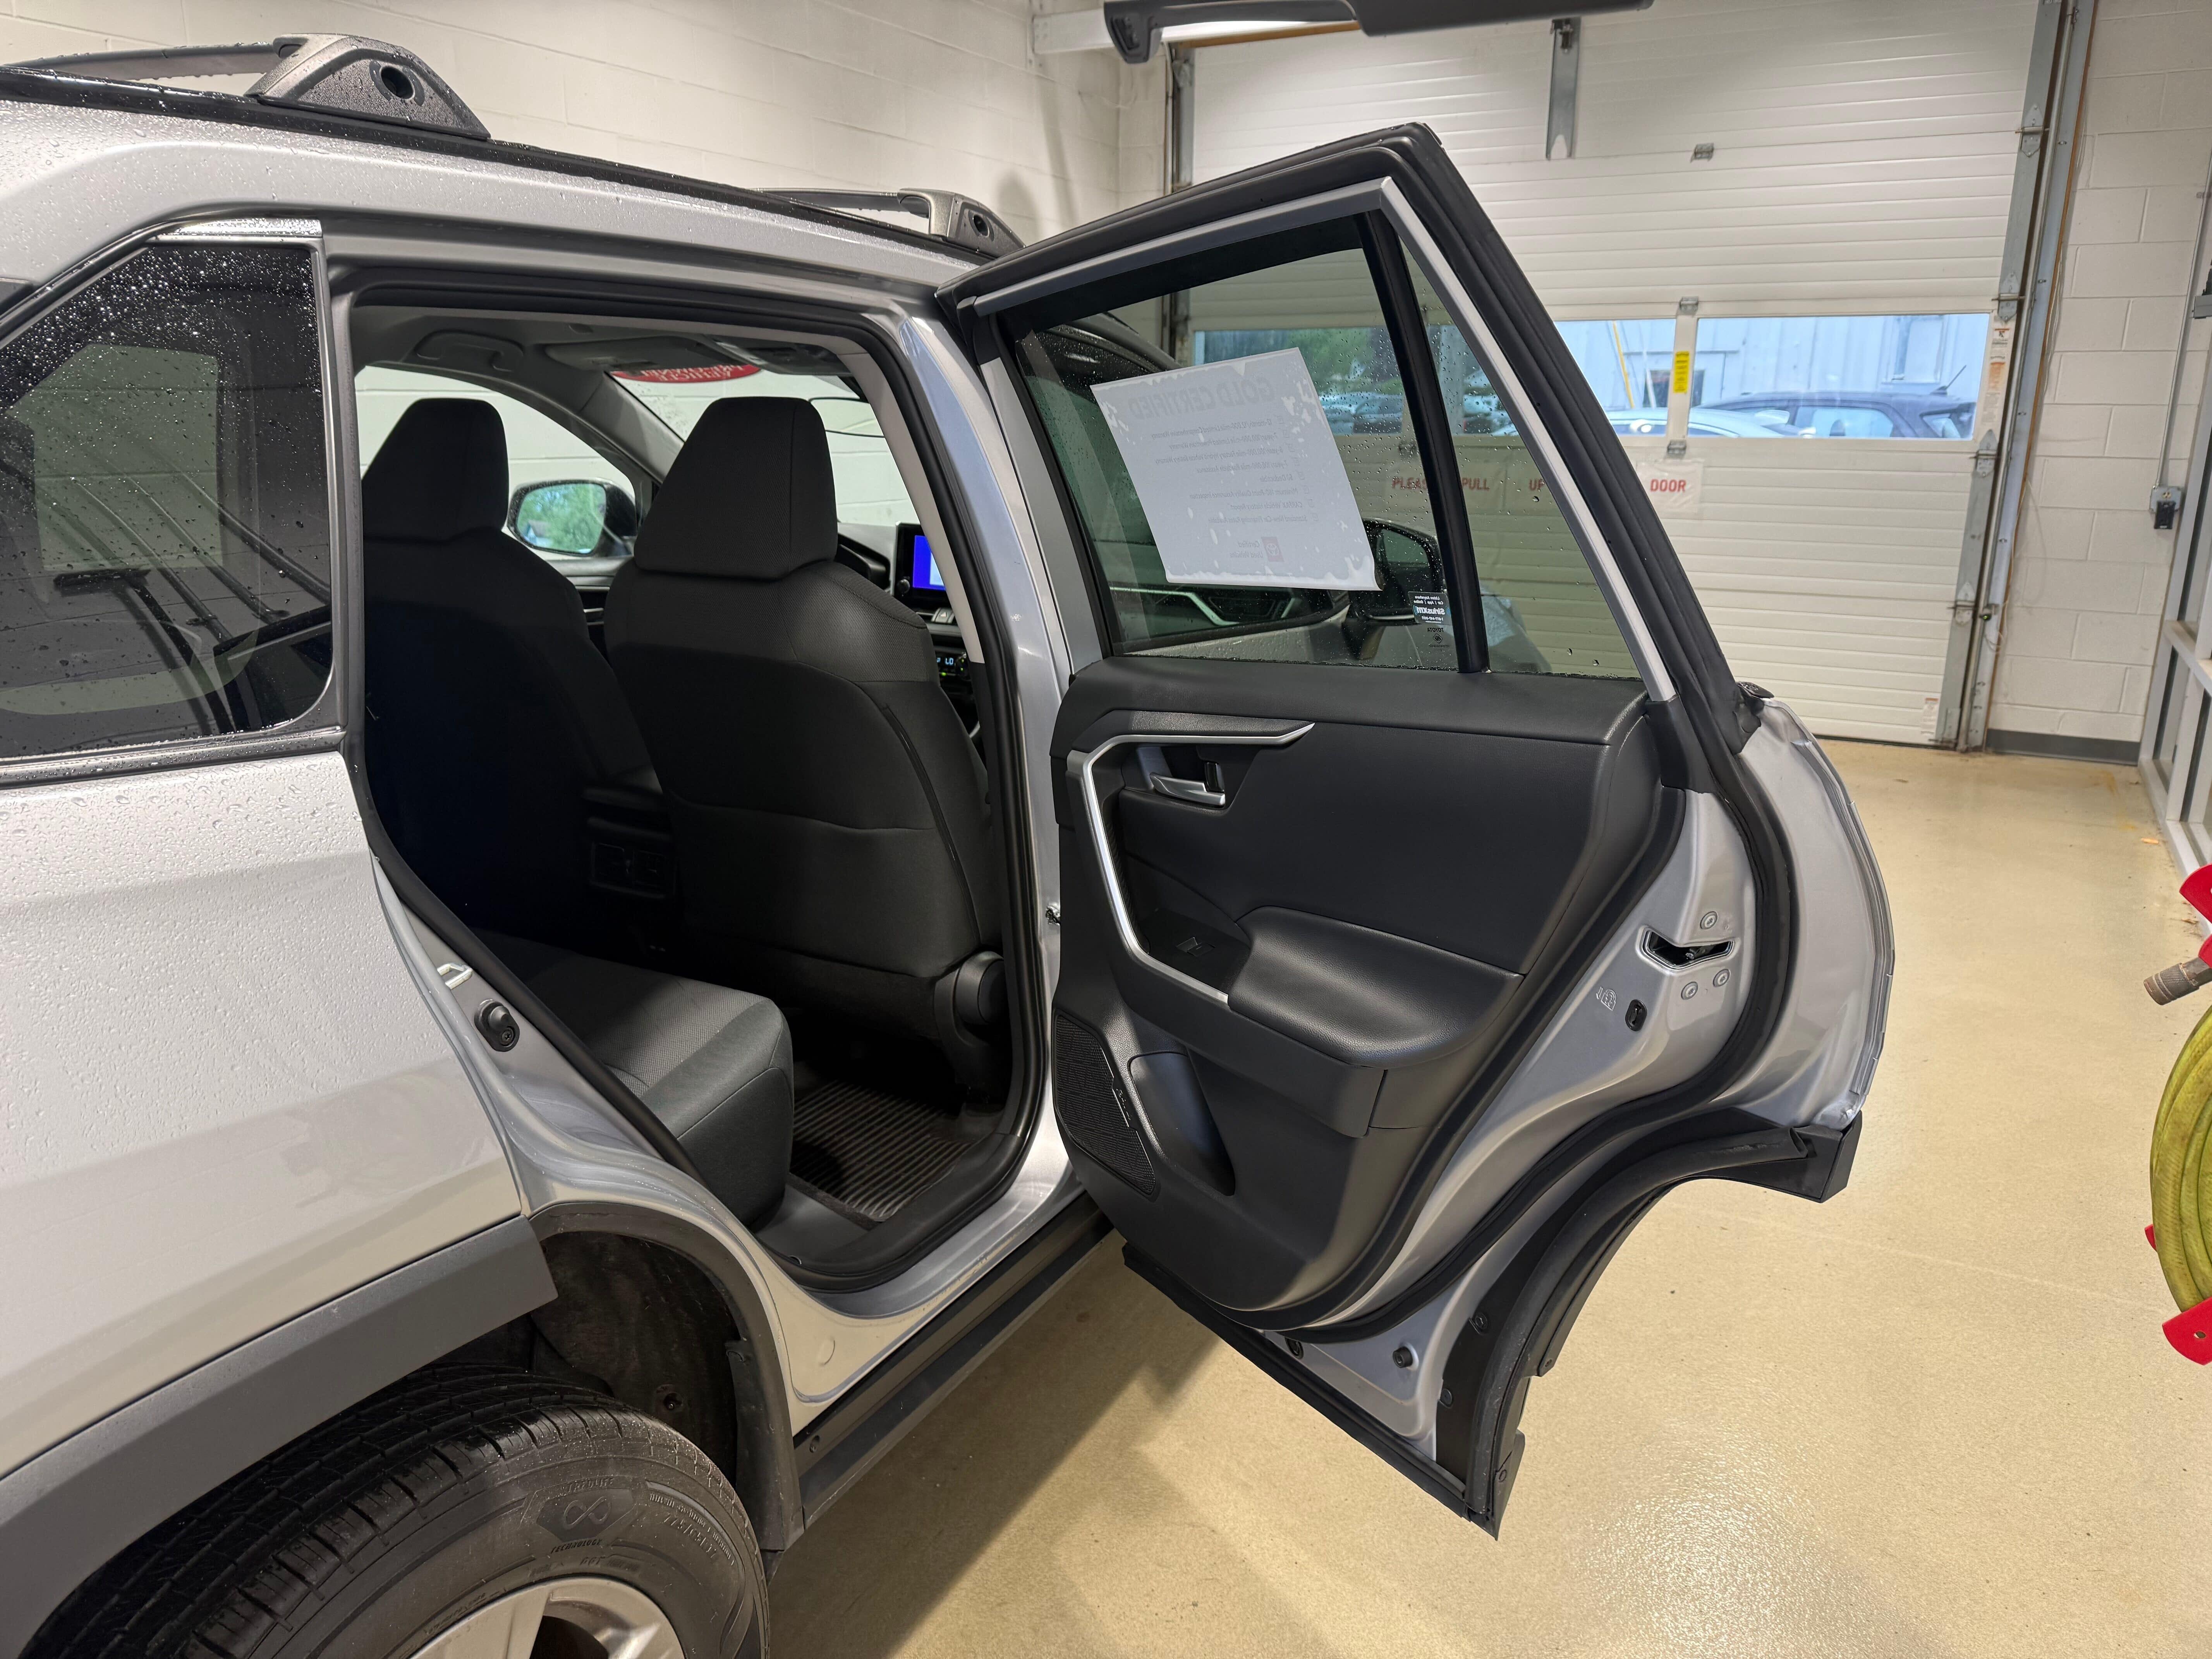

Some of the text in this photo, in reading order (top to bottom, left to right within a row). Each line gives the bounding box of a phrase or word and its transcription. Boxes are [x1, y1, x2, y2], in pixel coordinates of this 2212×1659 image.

[1392, 477, 1428, 490] PLEAS
[1650, 479, 1686, 492] DOOR
[551, 1539, 603, 1554] TECHNOLOGY
